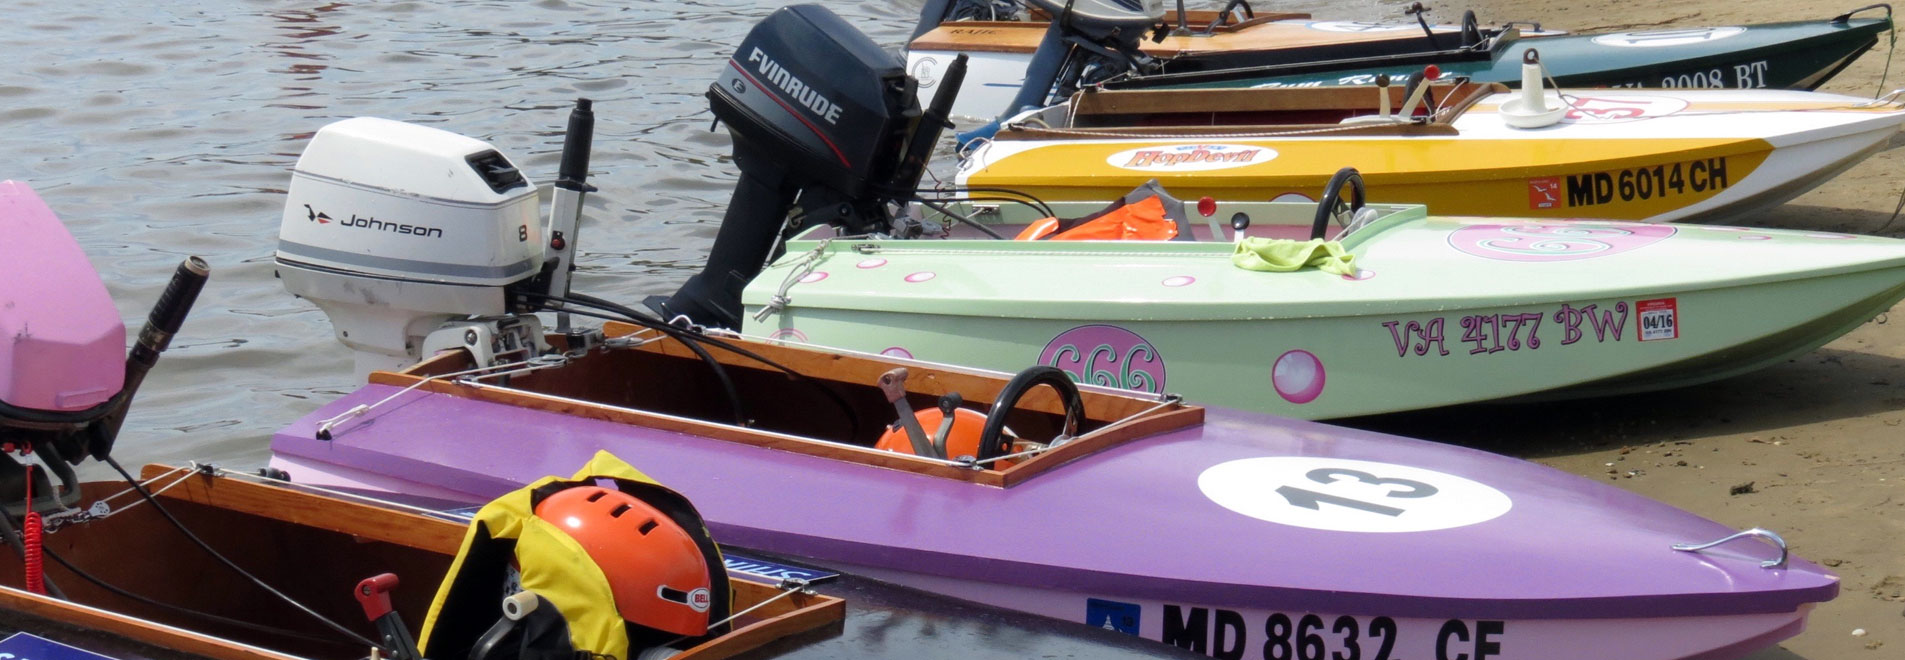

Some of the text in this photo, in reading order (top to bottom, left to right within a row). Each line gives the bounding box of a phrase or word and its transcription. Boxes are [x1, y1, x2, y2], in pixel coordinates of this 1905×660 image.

[1733, 60, 1768, 89] BT
[1123, 149, 1262, 168] HopDevil
[1566, 156, 1728, 207] MD 6014 CH
[340, 214, 443, 239] Johnson
[518, 224, 528, 243] 8
[1381, 301, 1629, 358] VA 4177 BW
[1643, 313, 1673, 330] 04/16
[1274, 467, 1439, 518] 13
[695, 593, 709, 603] BELL
[1162, 604, 1247, 660] MD
[1263, 612, 1400, 660] 8632
